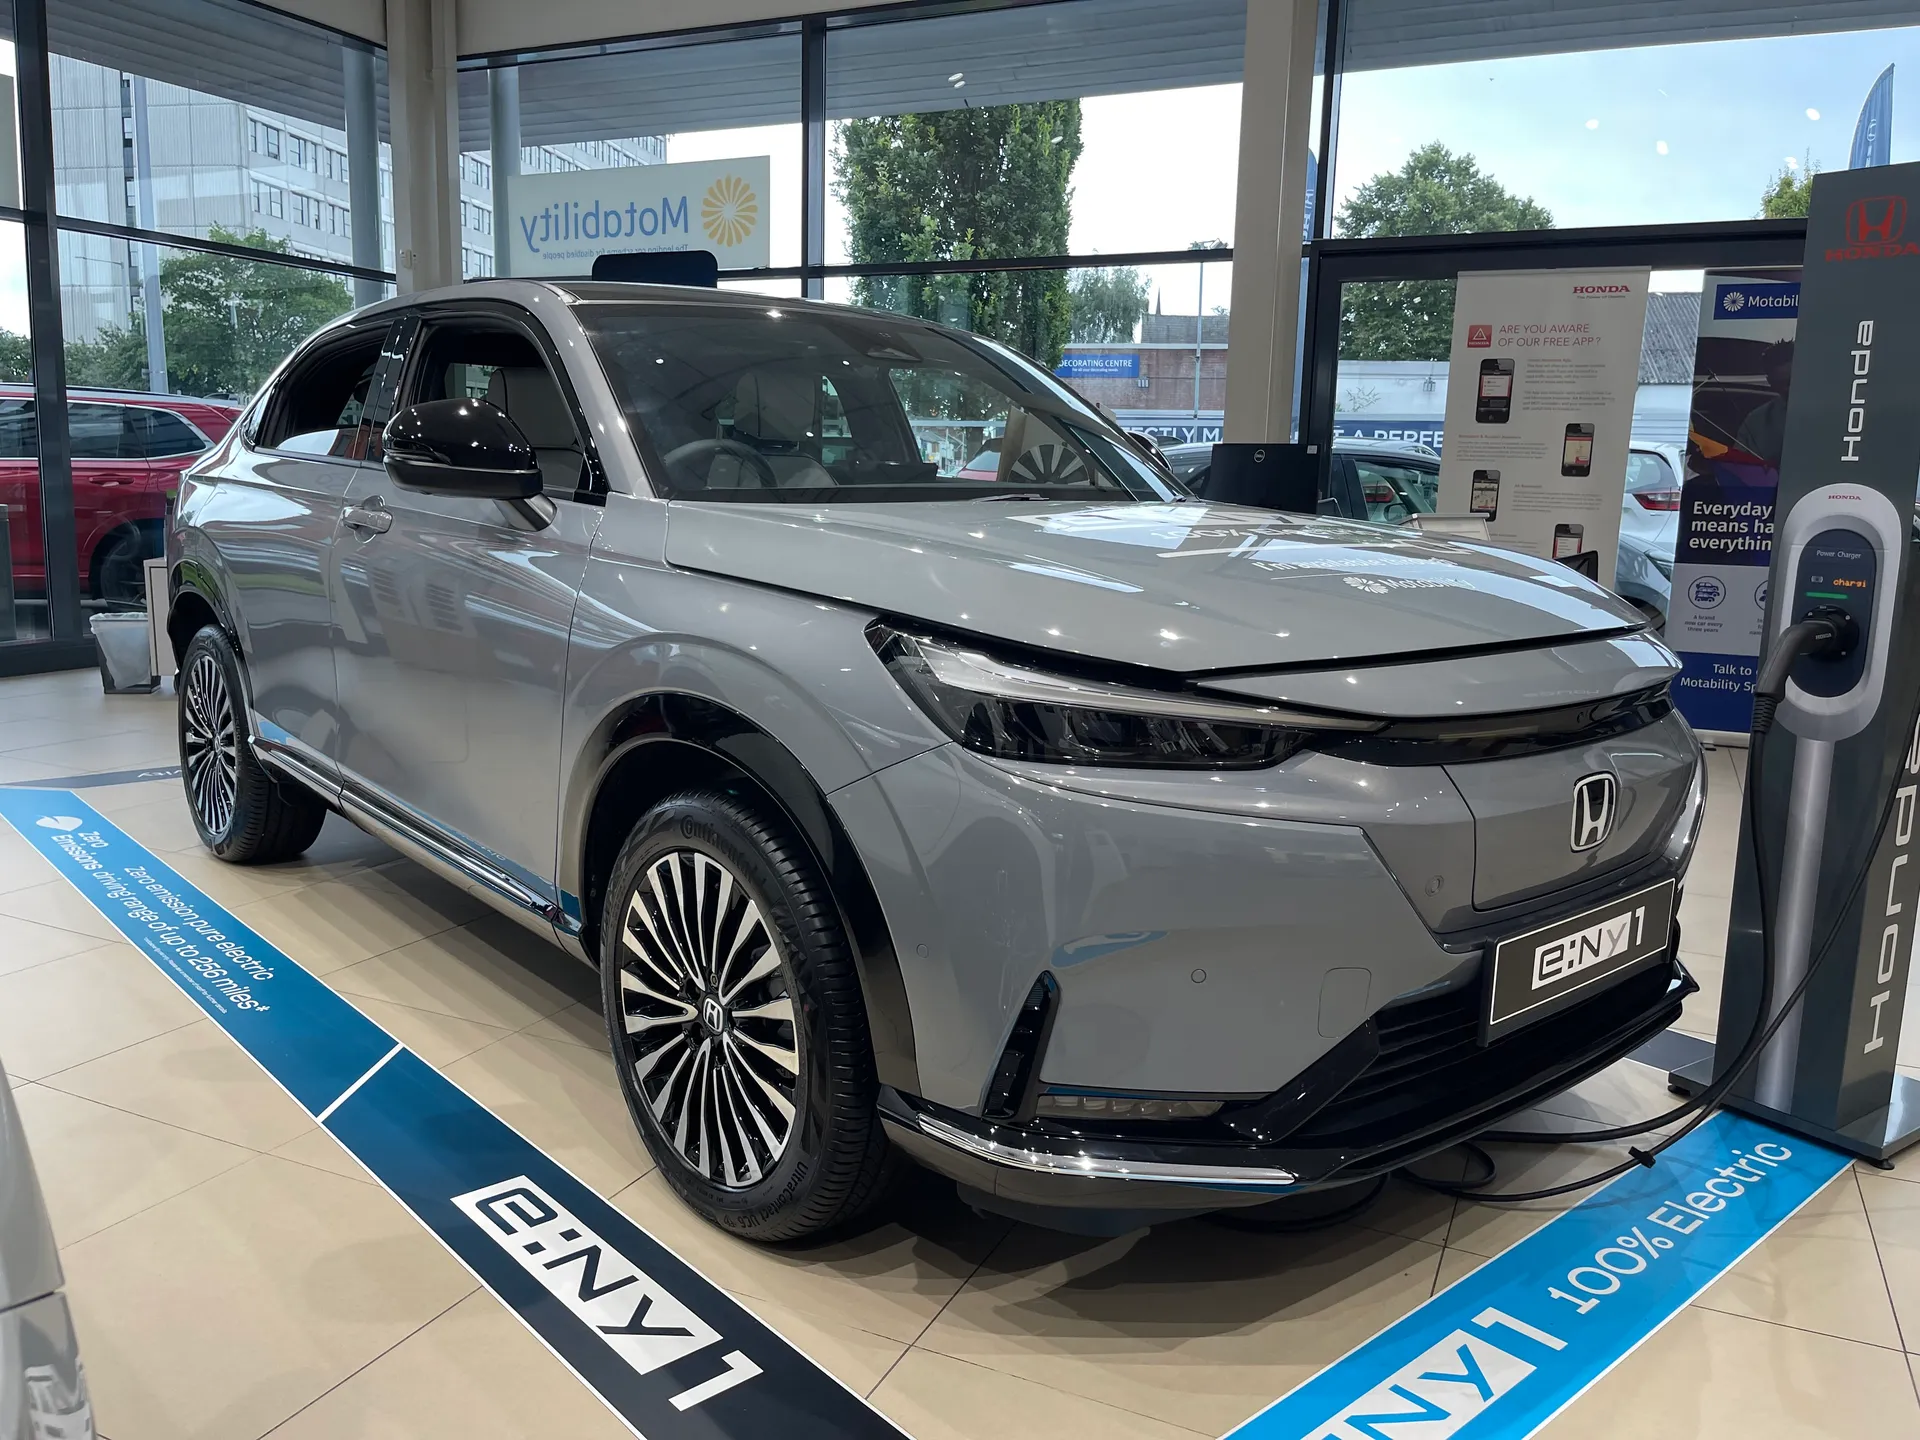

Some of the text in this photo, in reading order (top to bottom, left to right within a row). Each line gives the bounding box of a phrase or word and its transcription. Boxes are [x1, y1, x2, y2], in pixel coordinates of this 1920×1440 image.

[1825, 242, 1920, 262] HONDA
[1573, 285, 1631, 294] HONDA
[1748, 294, 1799, 308] Motabil
[1499, 323, 1589, 334] ARE YOU AWARE
[1498, 337, 1515, 347] OF
[1516, 337, 1540, 347] OUR
[1543, 337, 1570, 347] FREE
[1572, 336, 1594, 346] APP
[1060, 359, 1132, 368] DECORATING CENTRE
[1841, 320, 1874, 461] Honda
[1693, 501, 1773, 520] Everyday
[1691, 519, 1775, 534] means ha
[1689, 535, 1772, 553] everythin
[1816, 549, 1862, 560] Power Charger
[1713, 663, 1752, 676] Talk to
[1680, 677, 1741, 693] Motability
[78, 831, 109, 848] Zero
[51, 834, 103, 870] Emissions
[92, 871, 136, 899] driving
[119, 894, 160, 922] range
[124, 866, 155, 885] Zero
[145, 881, 200, 923] emission
[183, 917, 227, 943] pure
[215, 941, 275, 981] electric
[148, 921, 180, 933] of
[159, 931, 187, 948] up
[176, 944, 200, 958] to
[187, 956, 228, 979] 256
[1547, 1142, 1793, 1315] 100% Electric
